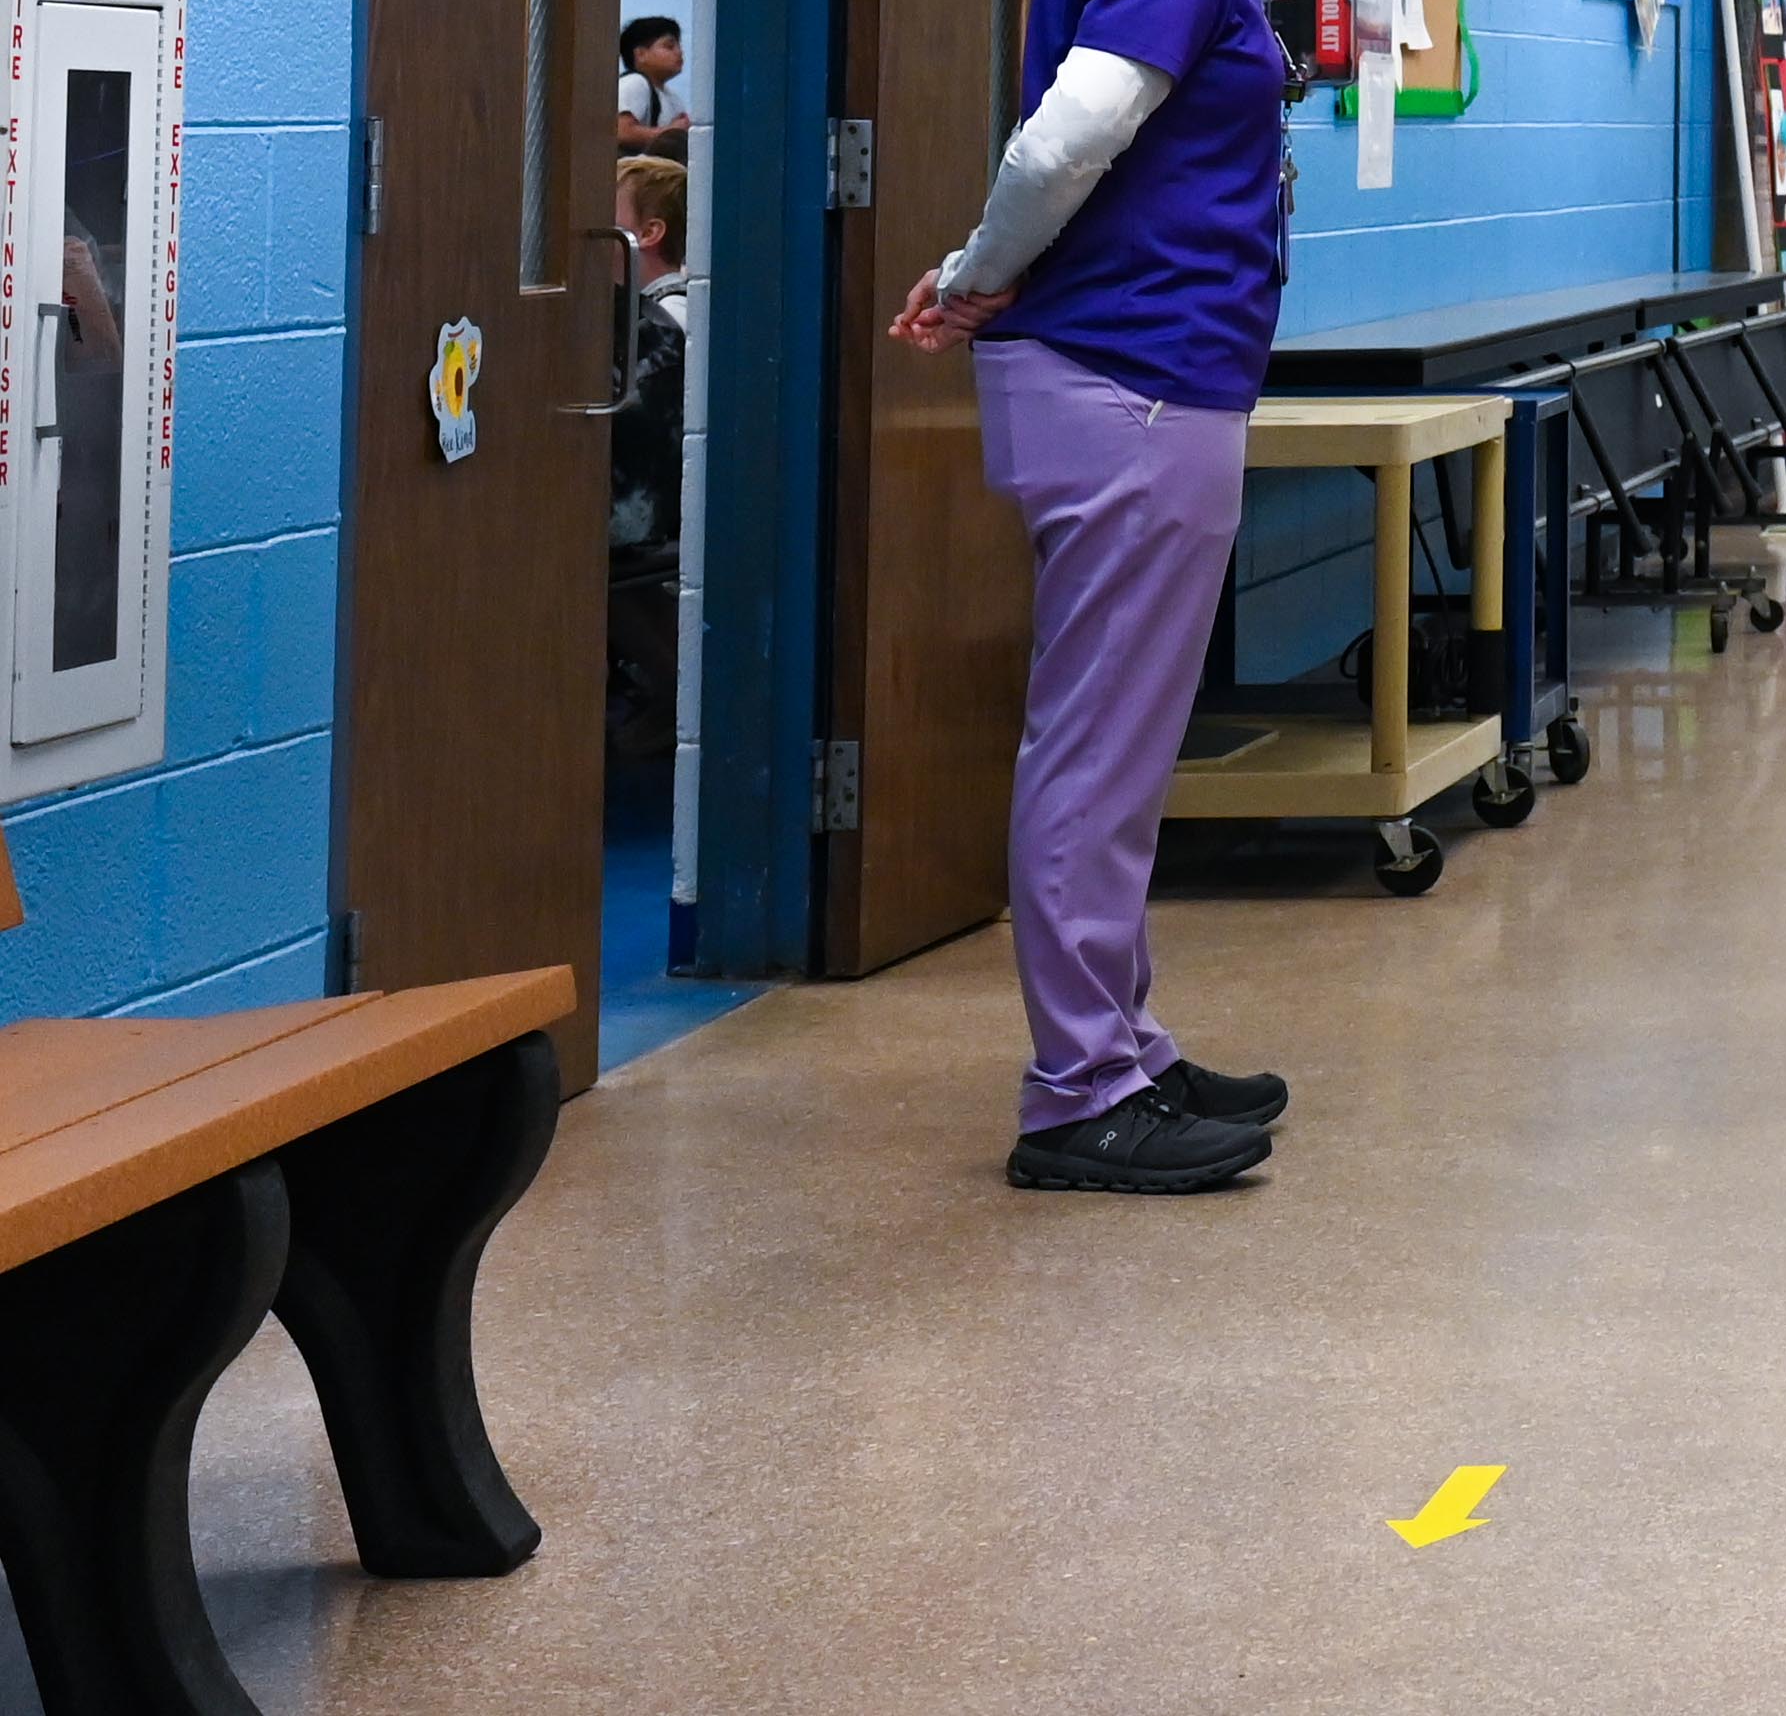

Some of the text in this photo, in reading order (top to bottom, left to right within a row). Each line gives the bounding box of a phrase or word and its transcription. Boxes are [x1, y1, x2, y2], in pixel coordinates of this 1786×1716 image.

[1321, 25, 1339, 53] KIT
[0, 117, 19, 486] EXTINGUISHER
[159, 123, 181, 471] EXTINGUISHER
